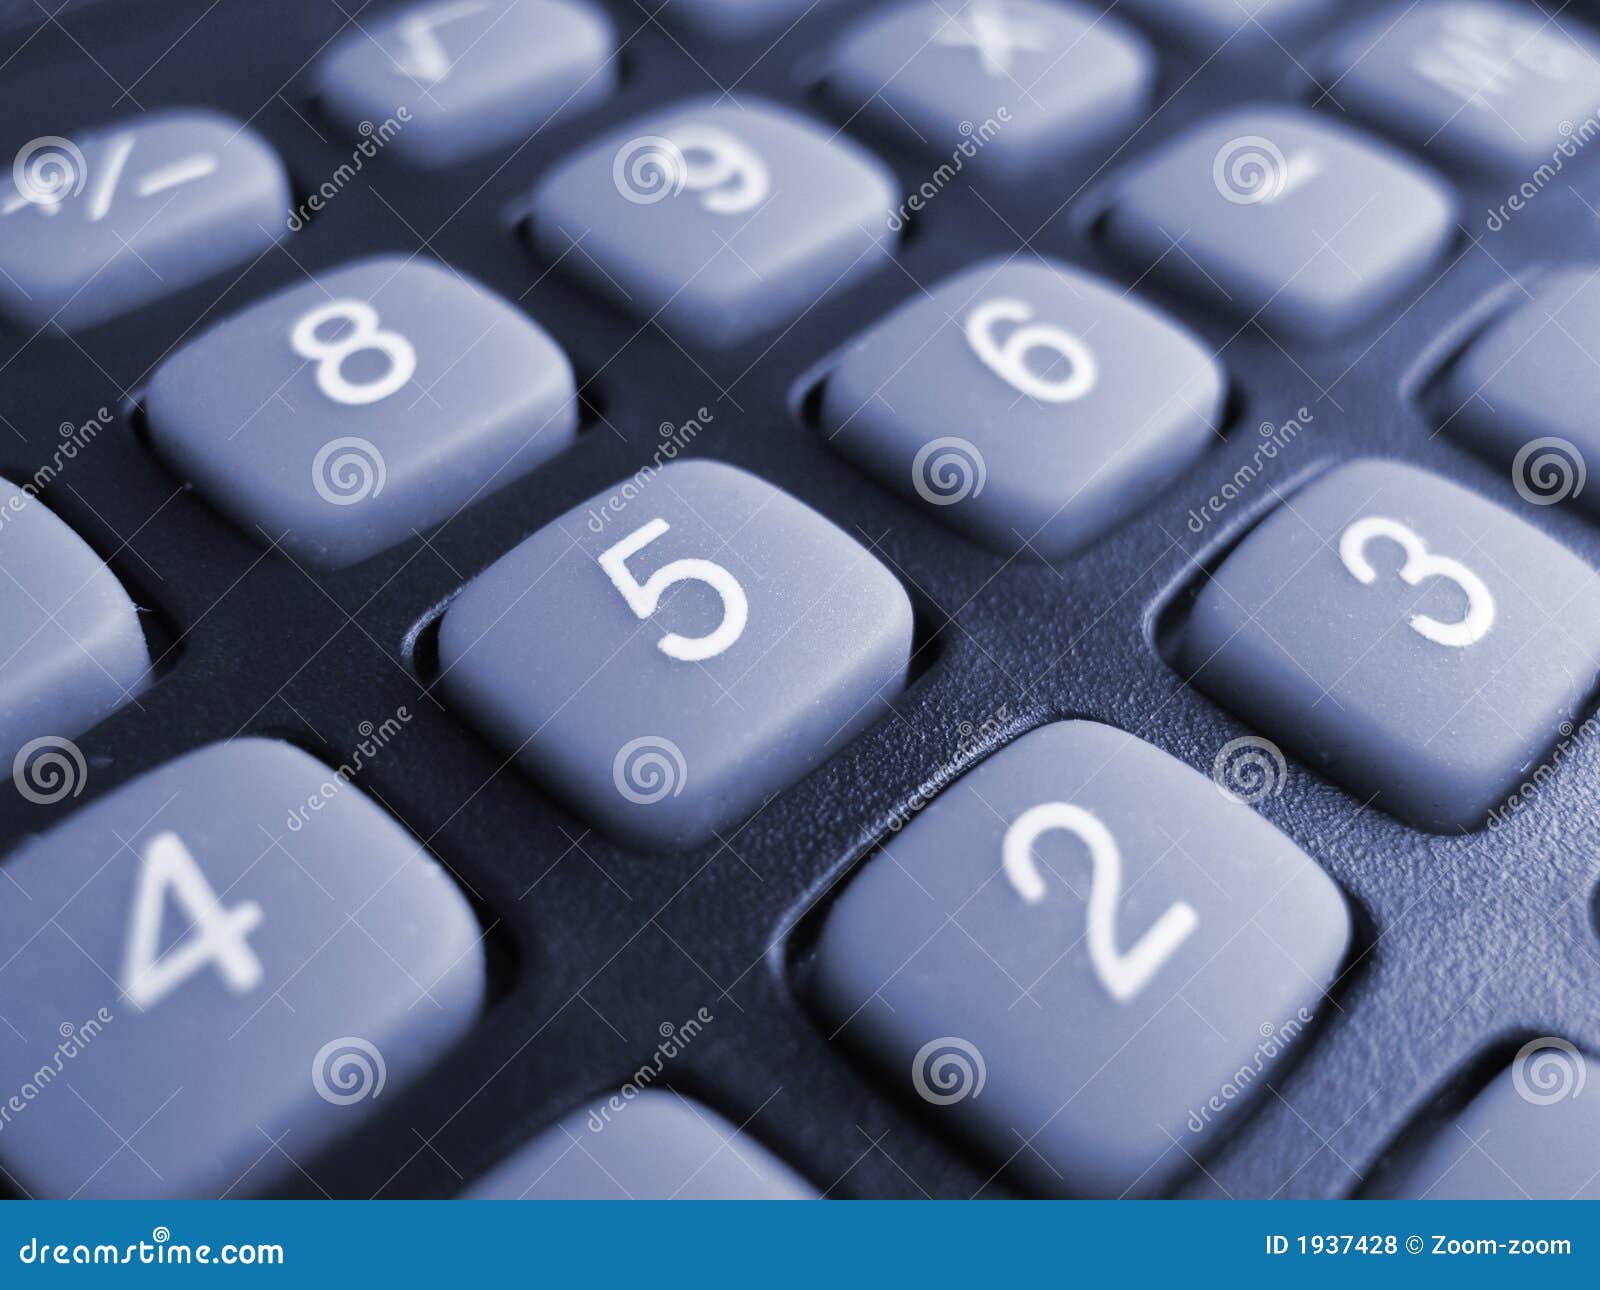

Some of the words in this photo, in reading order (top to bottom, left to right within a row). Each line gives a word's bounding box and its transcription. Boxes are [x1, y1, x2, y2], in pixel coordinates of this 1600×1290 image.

[662, 122, 769, 215] 9
[290, 299, 417, 405] 8
[964, 298, 1096, 402] 6
[598, 517, 748, 661] 5
[1339, 516, 1495, 648] 3
[123, 831, 265, 1013] 4
[1002, 801, 1199, 1001] 2
